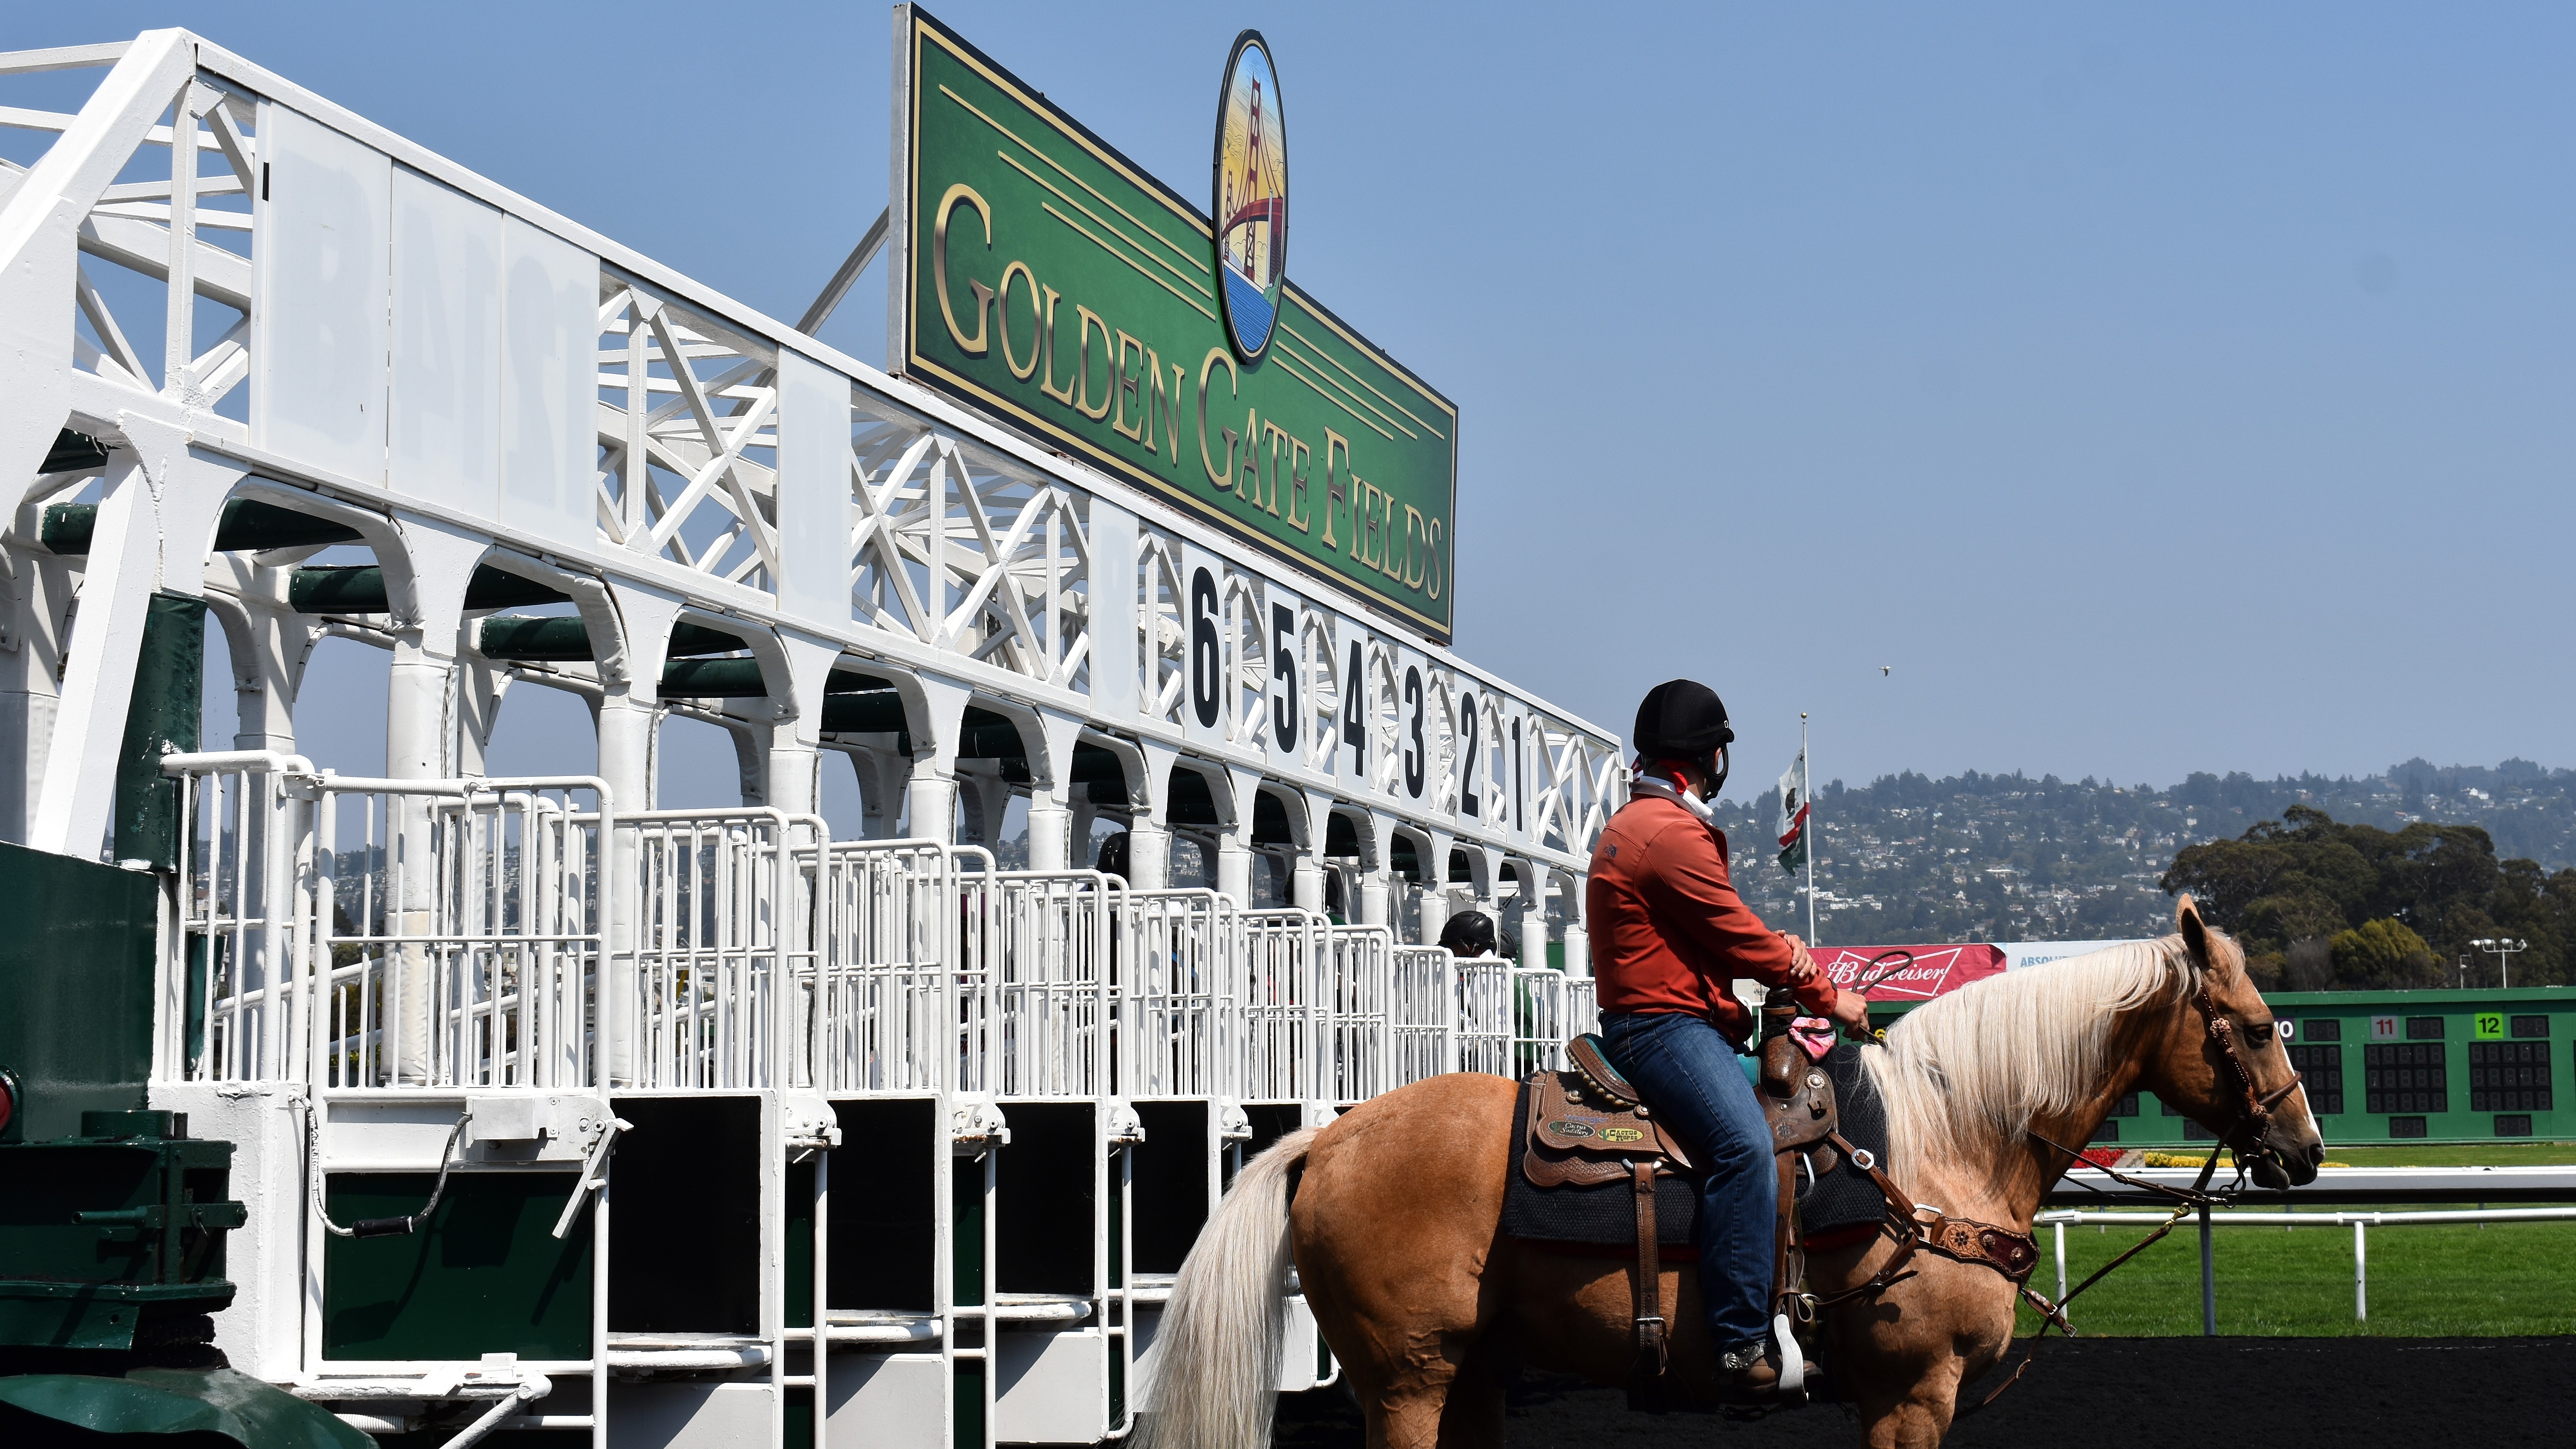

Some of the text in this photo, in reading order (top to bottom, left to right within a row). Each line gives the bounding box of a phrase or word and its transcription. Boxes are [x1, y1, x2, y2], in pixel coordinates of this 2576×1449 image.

[933, 183, 1442, 600] GOLDEN GATE FIELDS
[1191, 566, 1219, 728] 6
[1272, 601, 1297, 753] 5
[1344, 639, 1365, 777] 4
[1404, 664, 1424, 799] 3
[1461, 691, 1478, 818] 2
[1511, 715, 1523, 832] 1
[2376, 1019, 2392, 1034] 11
[2478, 1017, 2499, 1033] 12
[1564, 1113, 1609, 1125] Wrangler
